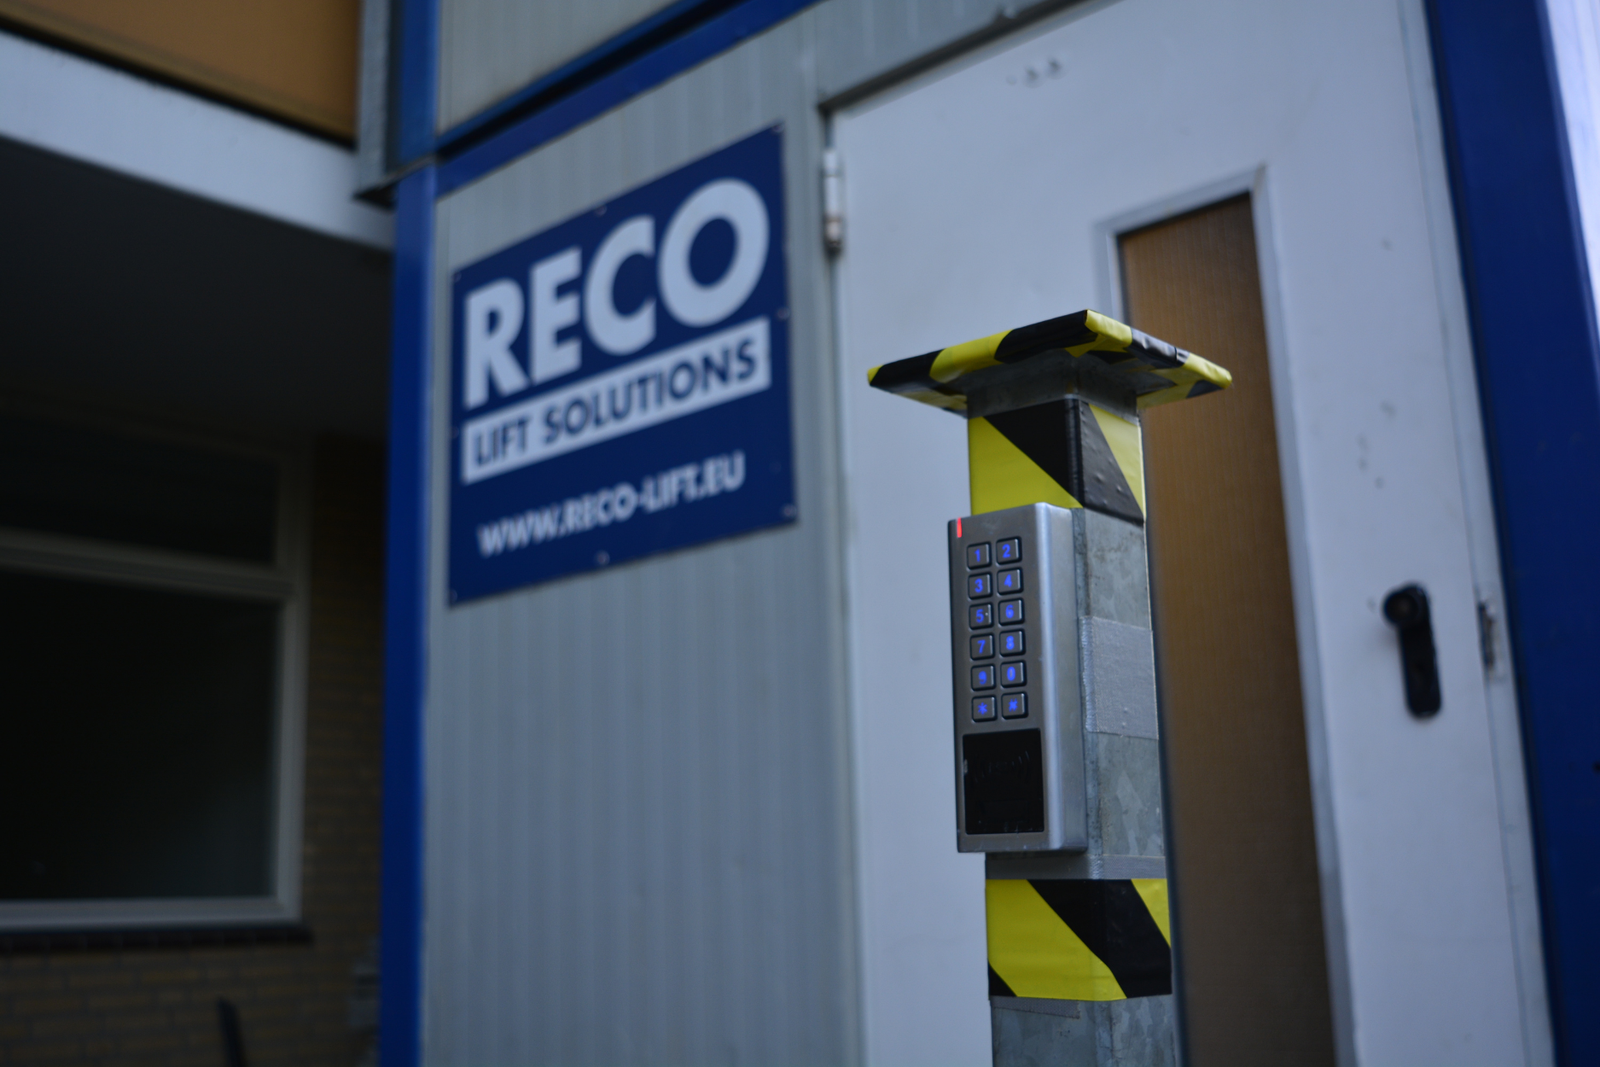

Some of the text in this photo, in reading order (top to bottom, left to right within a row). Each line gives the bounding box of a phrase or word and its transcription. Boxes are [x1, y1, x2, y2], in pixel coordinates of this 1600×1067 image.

[464, 178, 769, 410] RECO
[477, 338, 756, 467] LIFT SOLUTIONS
[476, 450, 746, 557] WWW.RECO-LIFT.EU
[974, 543, 1011, 562] 1 2
[974, 574, 1013, 593] 3 4
[976, 604, 1014, 623] 5 6
[977, 635, 1015, 654] 7 8
[978, 666, 1016, 685] 9 0
